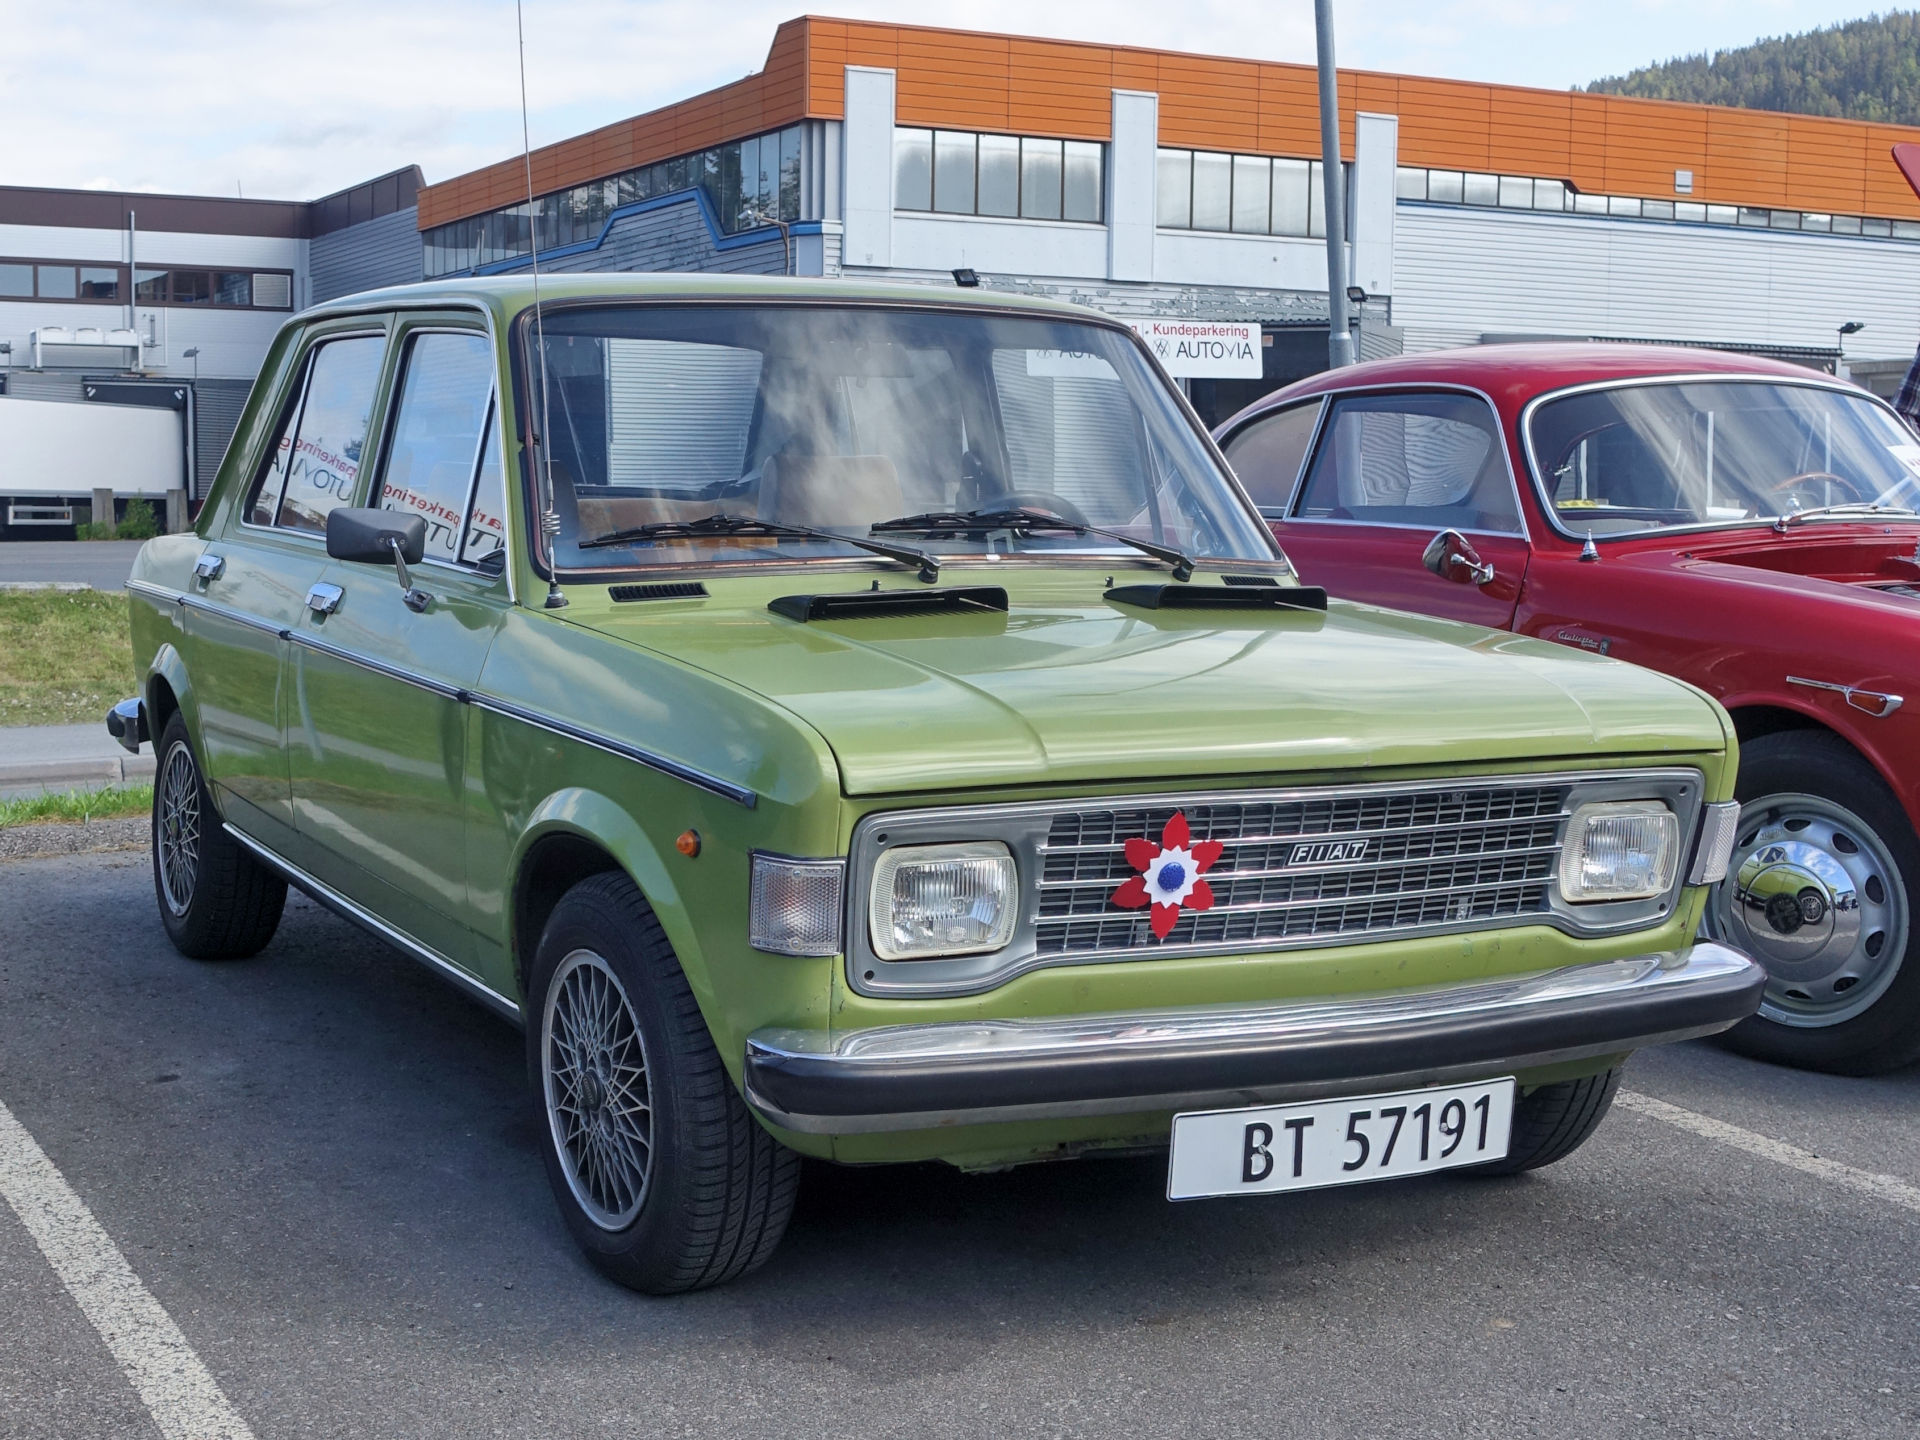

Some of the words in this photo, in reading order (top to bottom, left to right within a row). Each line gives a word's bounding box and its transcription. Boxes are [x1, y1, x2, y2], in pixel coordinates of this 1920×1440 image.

[1153, 323, 1249, 340] Kundeparkering
[1176, 341, 1254, 360] AUTOVIA
[1294, 842, 1365, 862] FIAT
[1242, 1116, 1315, 1183] BT
[1342, 1094, 1491, 1172] 57191
